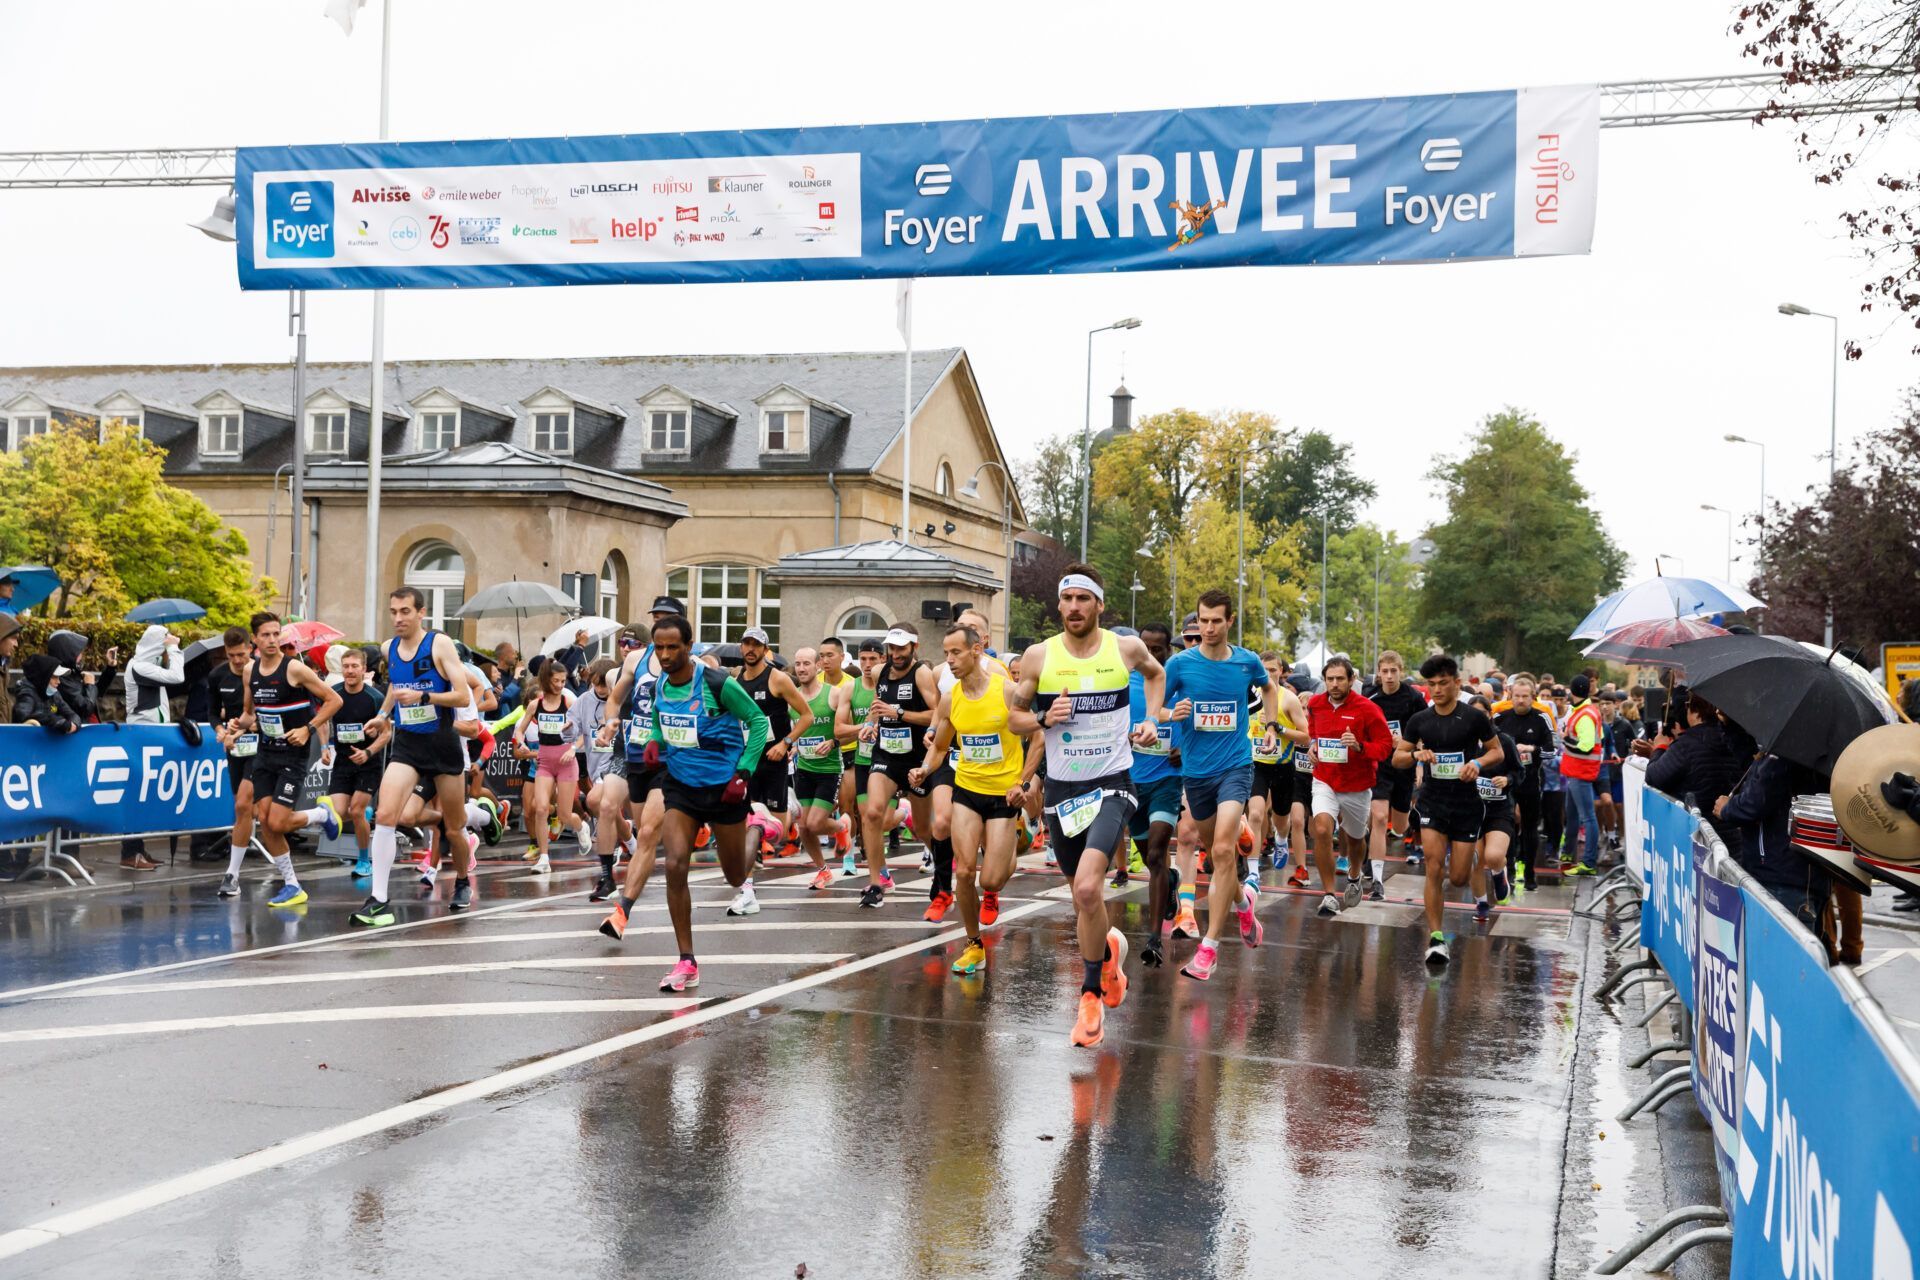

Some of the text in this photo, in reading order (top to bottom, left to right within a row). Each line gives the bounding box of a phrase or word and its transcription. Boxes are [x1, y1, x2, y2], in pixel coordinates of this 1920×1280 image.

[788, 179, 832, 189] ROLLINGER
[1530, 134, 1560, 224] FUJITSU
[592, 183, 638, 192] LOSCH
[653, 181, 693, 195] FUJITSU
[724, 179, 765, 193] klauner
[352, 188, 411, 203] Alvisse
[439, 188, 502, 201] emile weber
[1001, 144, 1357, 242] ARRIVEE
[821, 206, 833, 215] RTL
[1385, 185, 1496, 233] Foyer
[710, 215, 741, 223] PIDAL
[273, 219, 329, 247] Foyer
[392, 226, 417, 239] cebi
[522, 227, 558, 237] Cactus
[611, 218, 657, 241] help
[884, 209, 983, 254] Foyer
[689, 233, 702, 242] BIKE
[704, 232, 725, 242] WORLD
[1077, 693, 1118, 706] TRIATHLON
[407, 709, 427, 719] 182
[1211, 704, 1231, 713] Foyer
[671, 716, 690, 726] Foyer
[1201, 715, 1231, 726] 7179
[668, 729, 687, 741] 697
[889, 730, 906, 738] Foyer
[887, 740, 903, 748] 564
[974, 737, 994, 746] Foyer
[971, 747, 992, 758] 227
[1322, 749, 1340, 758] 562
[1441, 755, 1459, 763] Foyer
[1437, 764, 1456, 774] 467
[139, 746, 228, 815] Foyer
[1480, 787, 1497, 796] 083
[1073, 794, 1097, 808] Foyer
[1858, 783, 1900, 834] SABIAN
[1651, 825, 1669, 938] Foyer
[1763, 1014, 1841, 1280] Foyer
